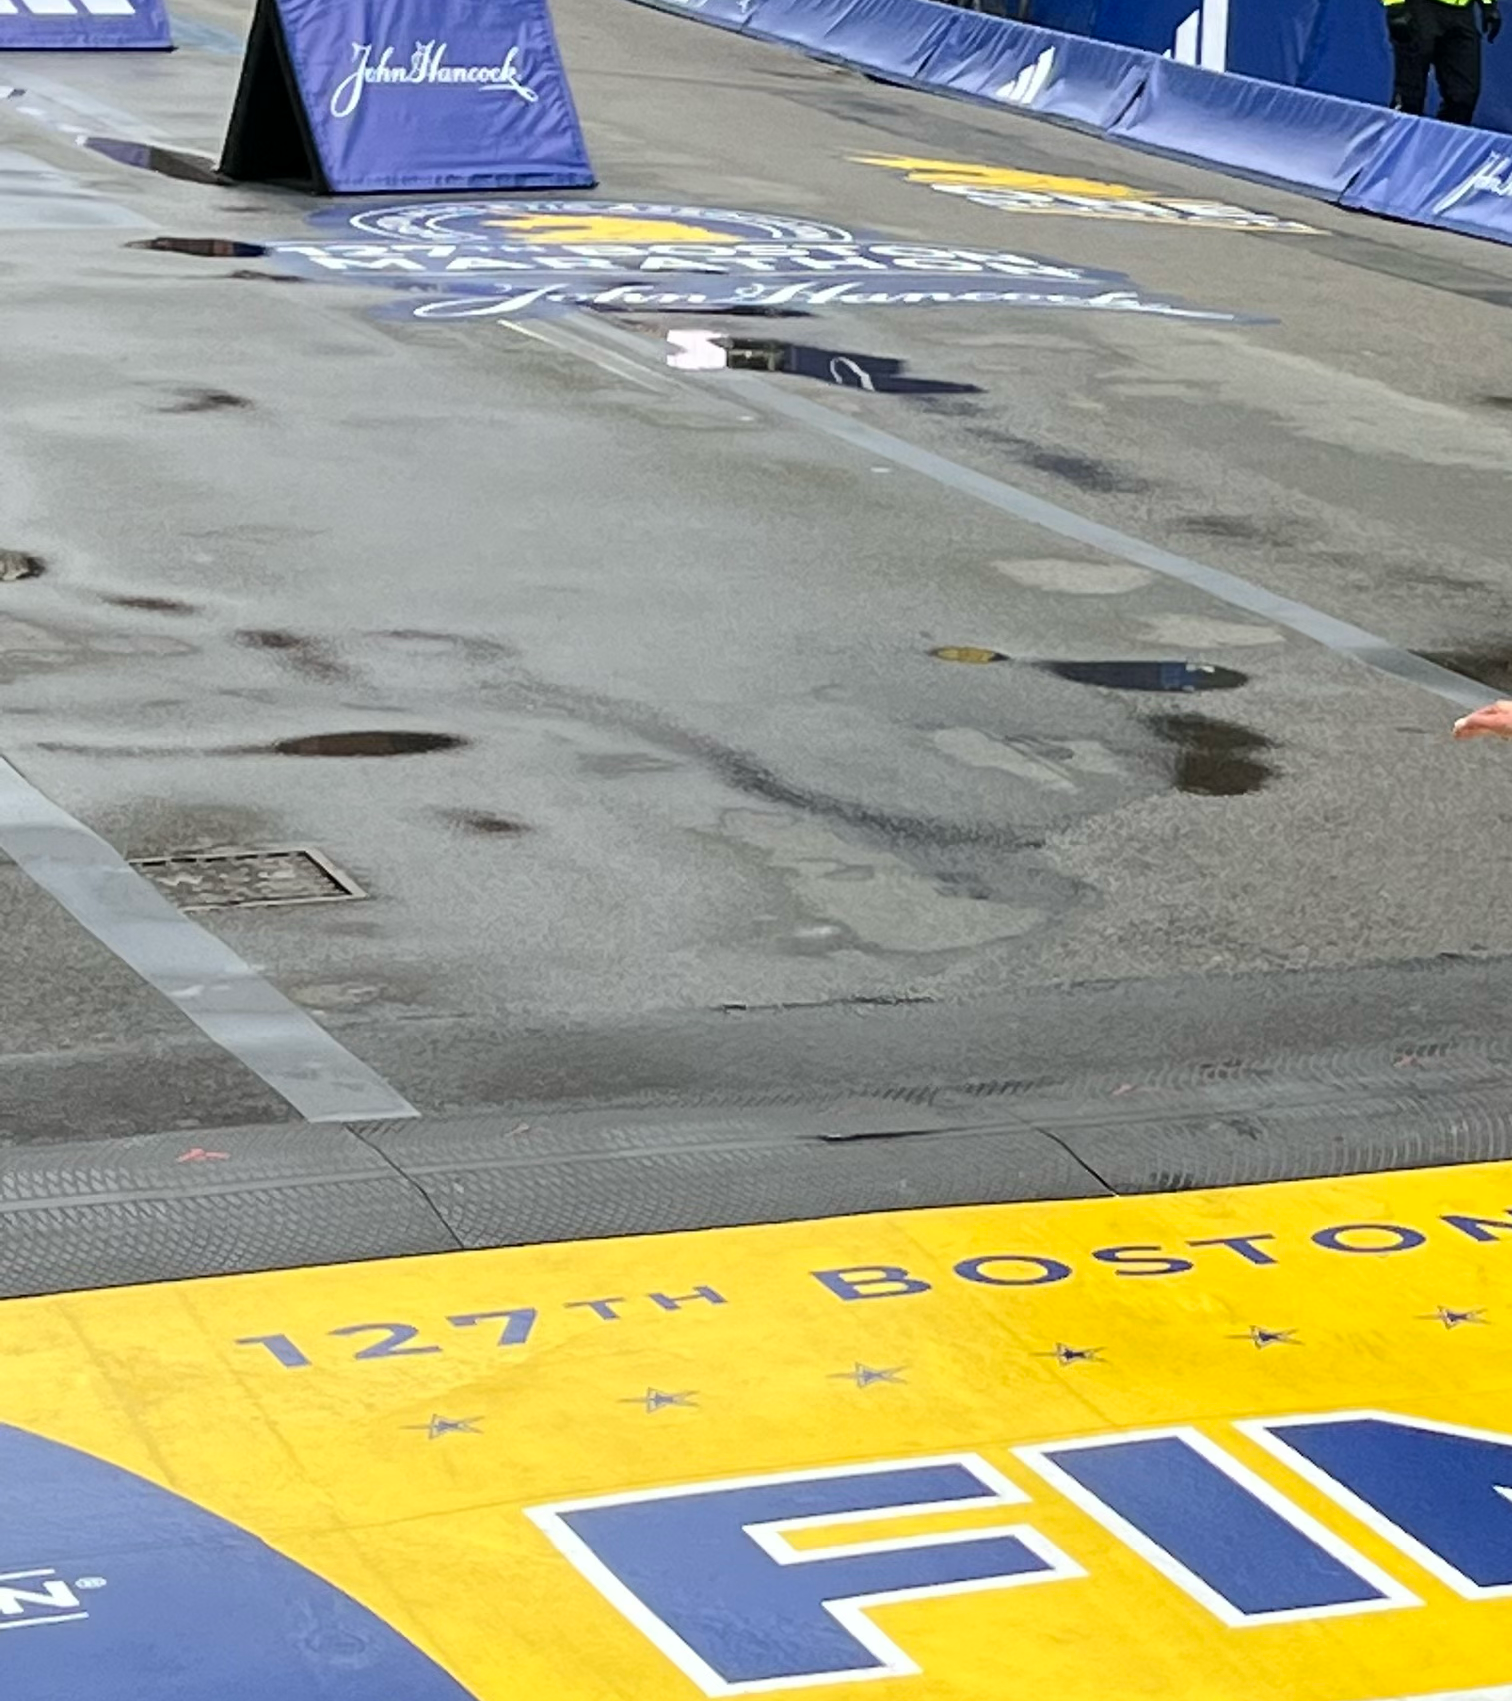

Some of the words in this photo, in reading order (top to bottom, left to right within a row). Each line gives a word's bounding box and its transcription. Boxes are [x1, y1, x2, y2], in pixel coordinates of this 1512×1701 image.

[331, 42, 411, 117] John
[409, 40, 539, 103] Hancock
[413, 281, 708, 318] John
[235, 1285, 729, 1369] 127TH
